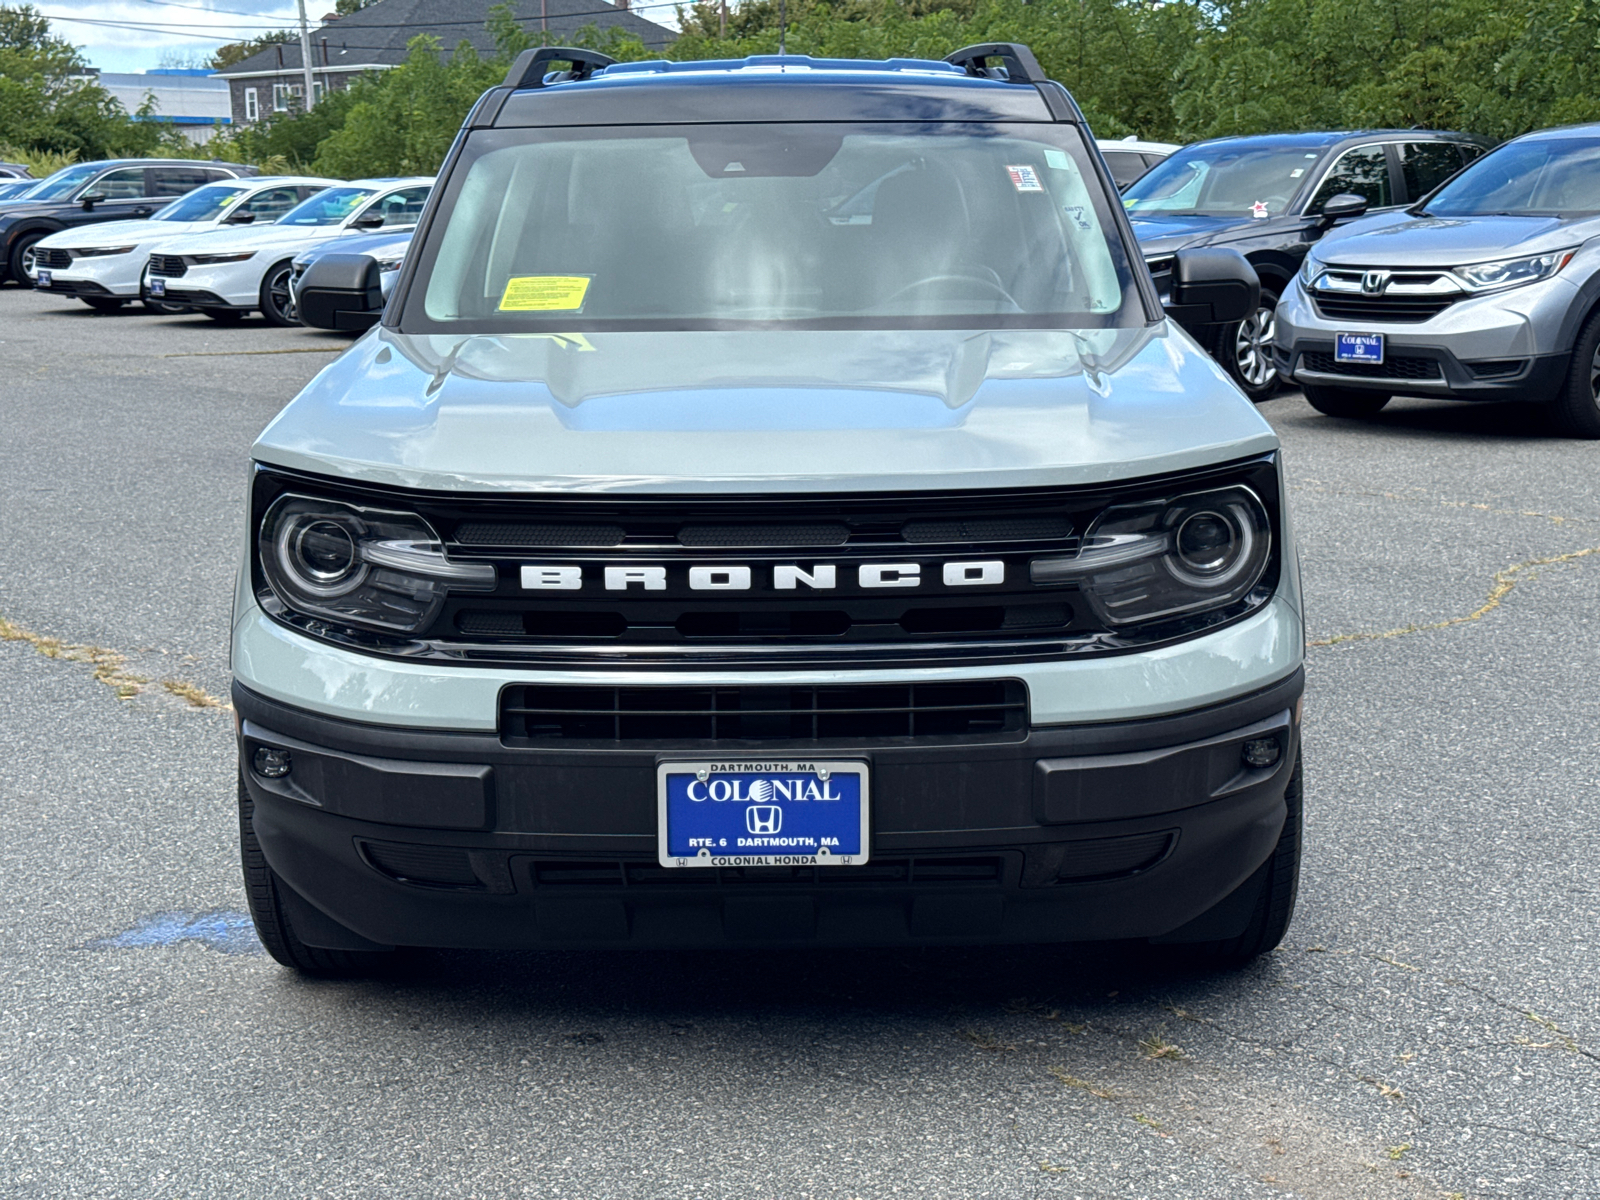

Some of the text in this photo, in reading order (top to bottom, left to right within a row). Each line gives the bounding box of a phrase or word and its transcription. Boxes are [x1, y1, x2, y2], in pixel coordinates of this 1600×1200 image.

[1342, 336, 1379, 345] COLONIAL
[520, 560, 1005, 591] BRONCO
[710, 763, 816, 772] DARTMOUTH, MA
[686, 779, 841, 803] COLONIAL
[688, 837, 840, 848] RTE. 6 DARTMOUTH, MA
[710, 856, 818, 866] COLONIAL HONDA
